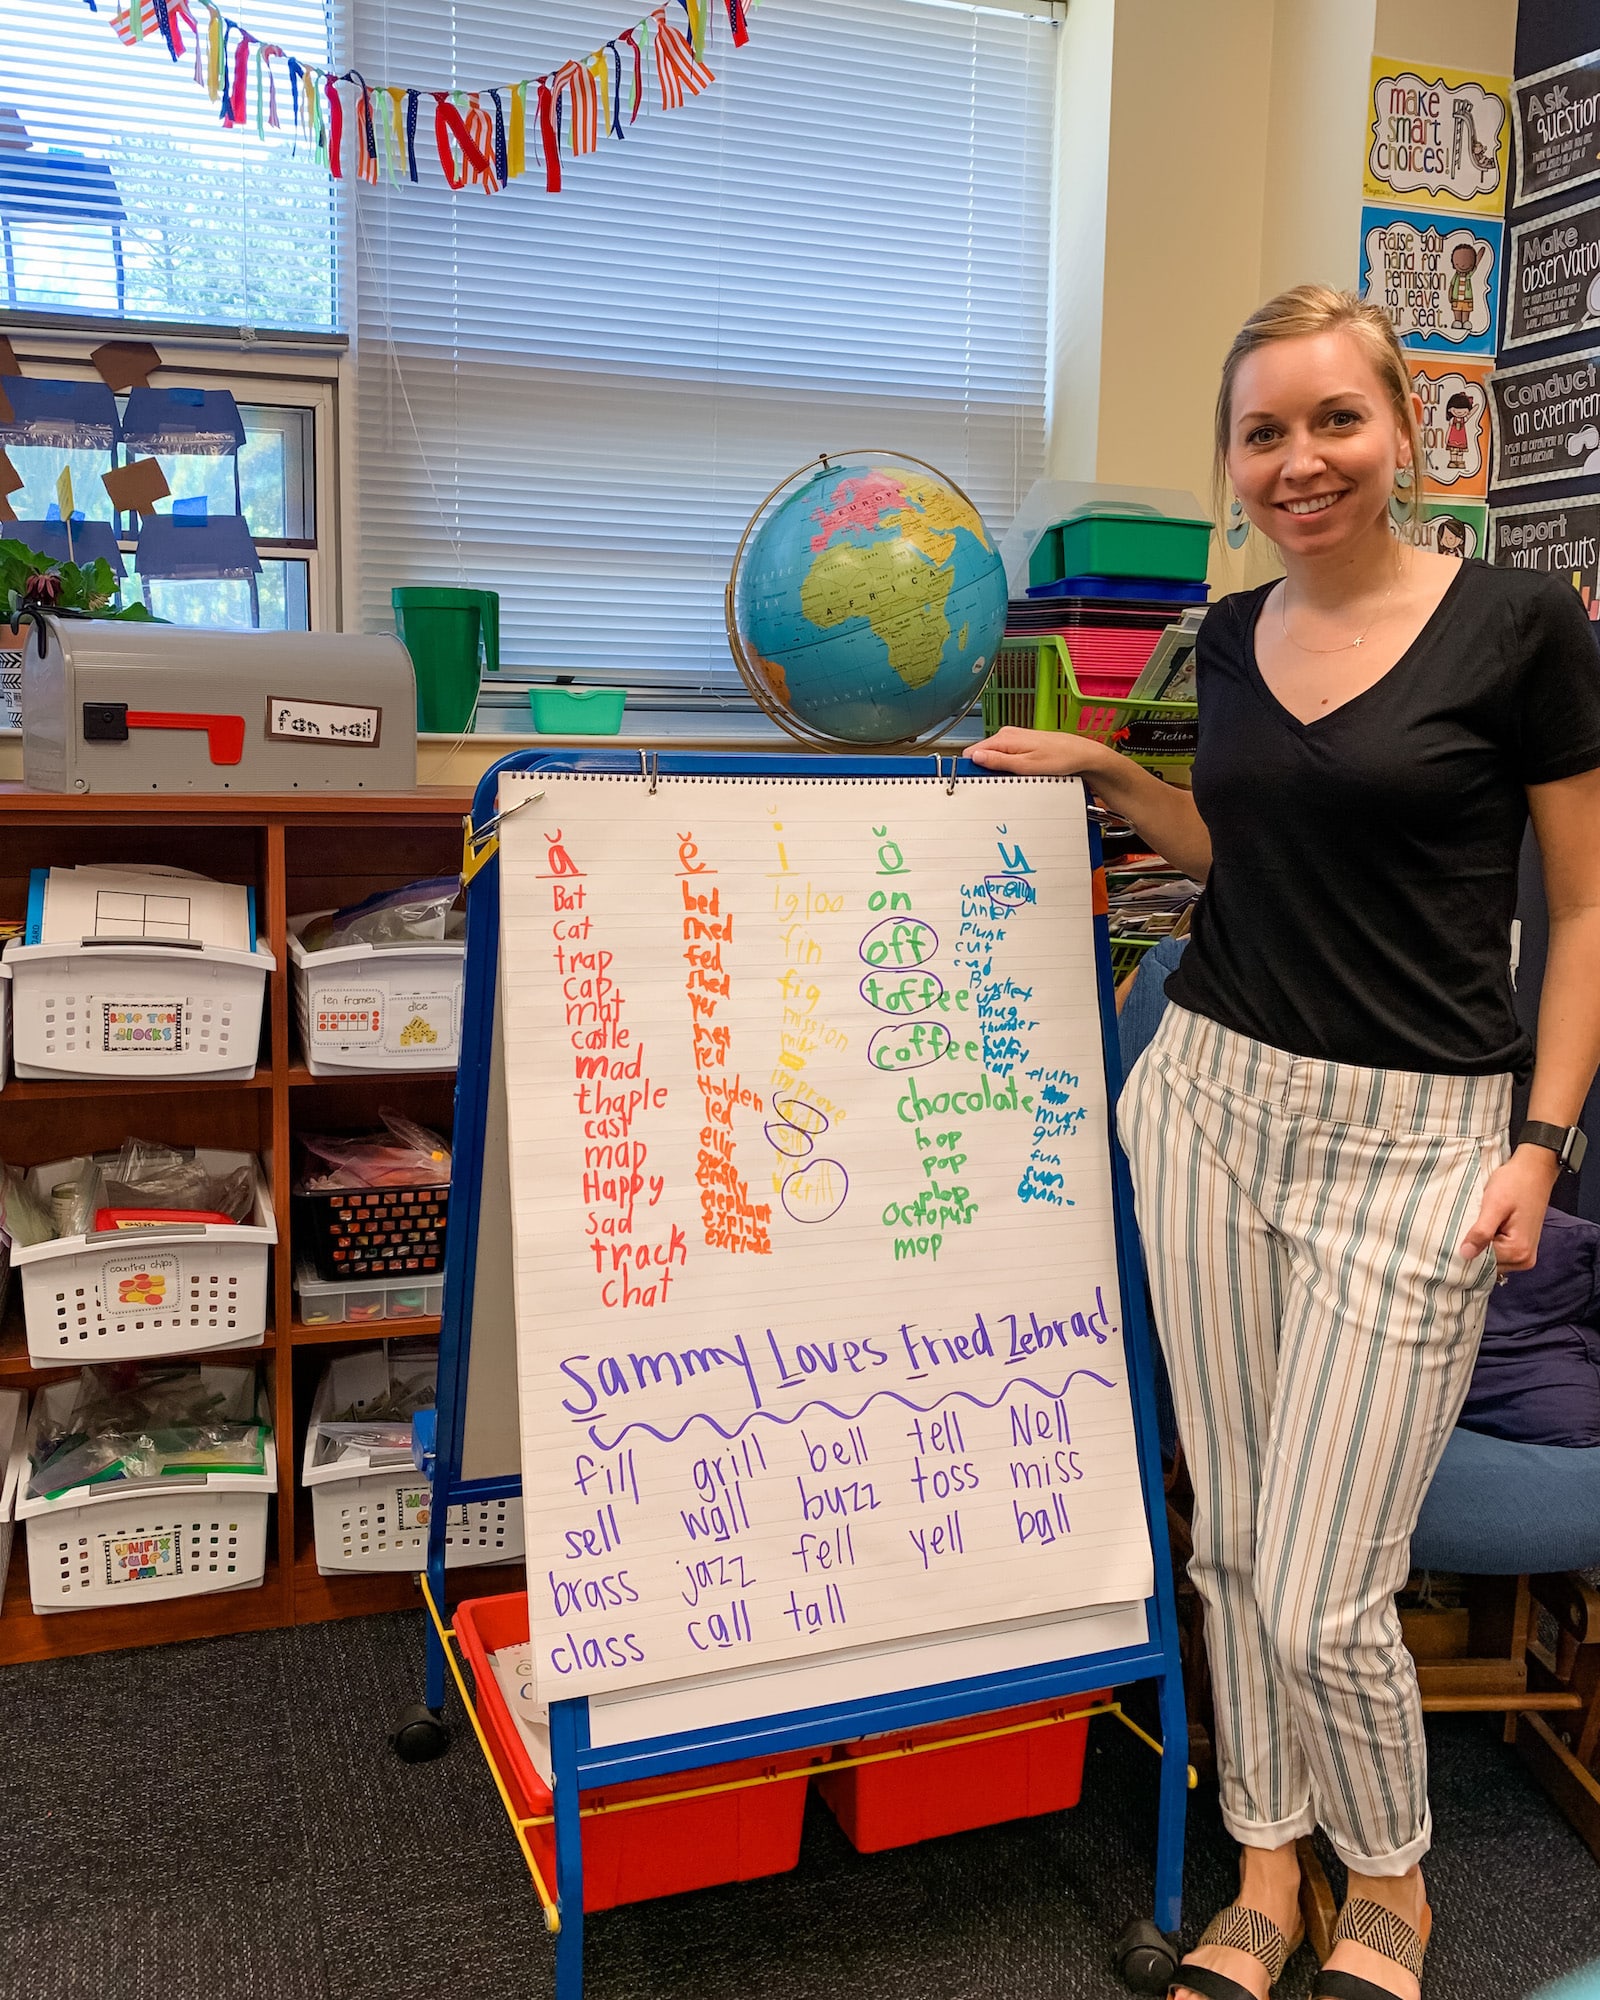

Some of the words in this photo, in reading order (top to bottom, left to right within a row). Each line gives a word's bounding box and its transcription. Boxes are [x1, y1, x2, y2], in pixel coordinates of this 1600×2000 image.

[1390, 88, 1440, 118] make
[1528, 85, 1570, 122] Ask
[1387, 116, 1441, 145] smart
[1379, 231, 1414, 252] Raise
[1523, 227, 1578, 265] Make
[1384, 251, 1415, 270] hand
[1421, 253, 1441, 271] for
[1522, 239, 1600, 293] observatio
[1385, 289, 1399, 306] to
[1405, 290, 1440, 308] leave
[1503, 363, 1596, 409] Conduct
[1513, 412, 1530, 436] an
[1533, 393, 1600, 431] experimen
[1500, 514, 1567, 549] Report
[1547, 536, 1596, 572] results
[826, 569, 936, 616] AFRICA
[1151, 730, 1193, 741] Fiction
[553, 885, 587, 911] Bat
[682, 880, 719, 917] bed
[868, 890, 911, 911] on
[553, 916, 593, 940] cat
[780, 923, 822, 964] fin
[867, 925, 926, 965] off
[553, 945, 613, 980] trap
[683, 942, 723, 974] fed
[322, 994, 338, 1005] ten
[344, 995, 376, 1005] frames
[407, 1002, 428, 1013] dice
[563, 976, 612, 1008] cap
[567, 988, 625, 1025] mat
[777, 968, 821, 1017] fig
[866, 978, 969, 1012] toffee
[576, 1043, 643, 1079] mad
[876, 1025, 979, 1070] coffee
[897, 1074, 1035, 1123] chocolate
[915, 1127, 962, 1151] hop
[1032, 1124, 1077, 1146] guts
[585, 1141, 647, 1172] map
[922, 1153, 967, 1178] pop
[1030, 1149, 1060, 1165] fun
[583, 1170, 664, 1209] Happy
[585, 1204, 633, 1236] sad
[590, 1224, 687, 1273] track
[894, 1234, 943, 1262] mop
[110, 1263, 146, 1273] counting
[150, 1259, 173, 1270] chips
[559, 1334, 762, 1418] Sammy
[767, 1329, 888, 1384] Loves
[898, 1313, 994, 1374] Fried
[997, 1285, 1118, 1360] Zebras!
[574, 1448, 640, 1505] fill
[693, 1433, 767, 1503] grill
[801, 1426, 868, 1472] bell
[907, 1411, 965, 1454] tell
[1011, 1399, 1071, 1447] Nell
[566, 1504, 622, 1560] sell
[680, 1481, 750, 1541] wall
[797, 1476, 882, 1521] buzz
[911, 1456, 980, 1503] toss
[1010, 1451, 1084, 1489] miss
[115, 1537, 171, 1556] UNIFIX
[548, 1570, 639, 1617] brass
[675, 1555, 757, 1607] jazz
[792, 1524, 855, 1573] fell
[909, 1510, 963, 1570] yell
[1013, 1492, 1071, 1543] ball
[551, 1633, 645, 1674] class
[688, 1600, 752, 1650] call
[784, 1584, 846, 1632] tall
